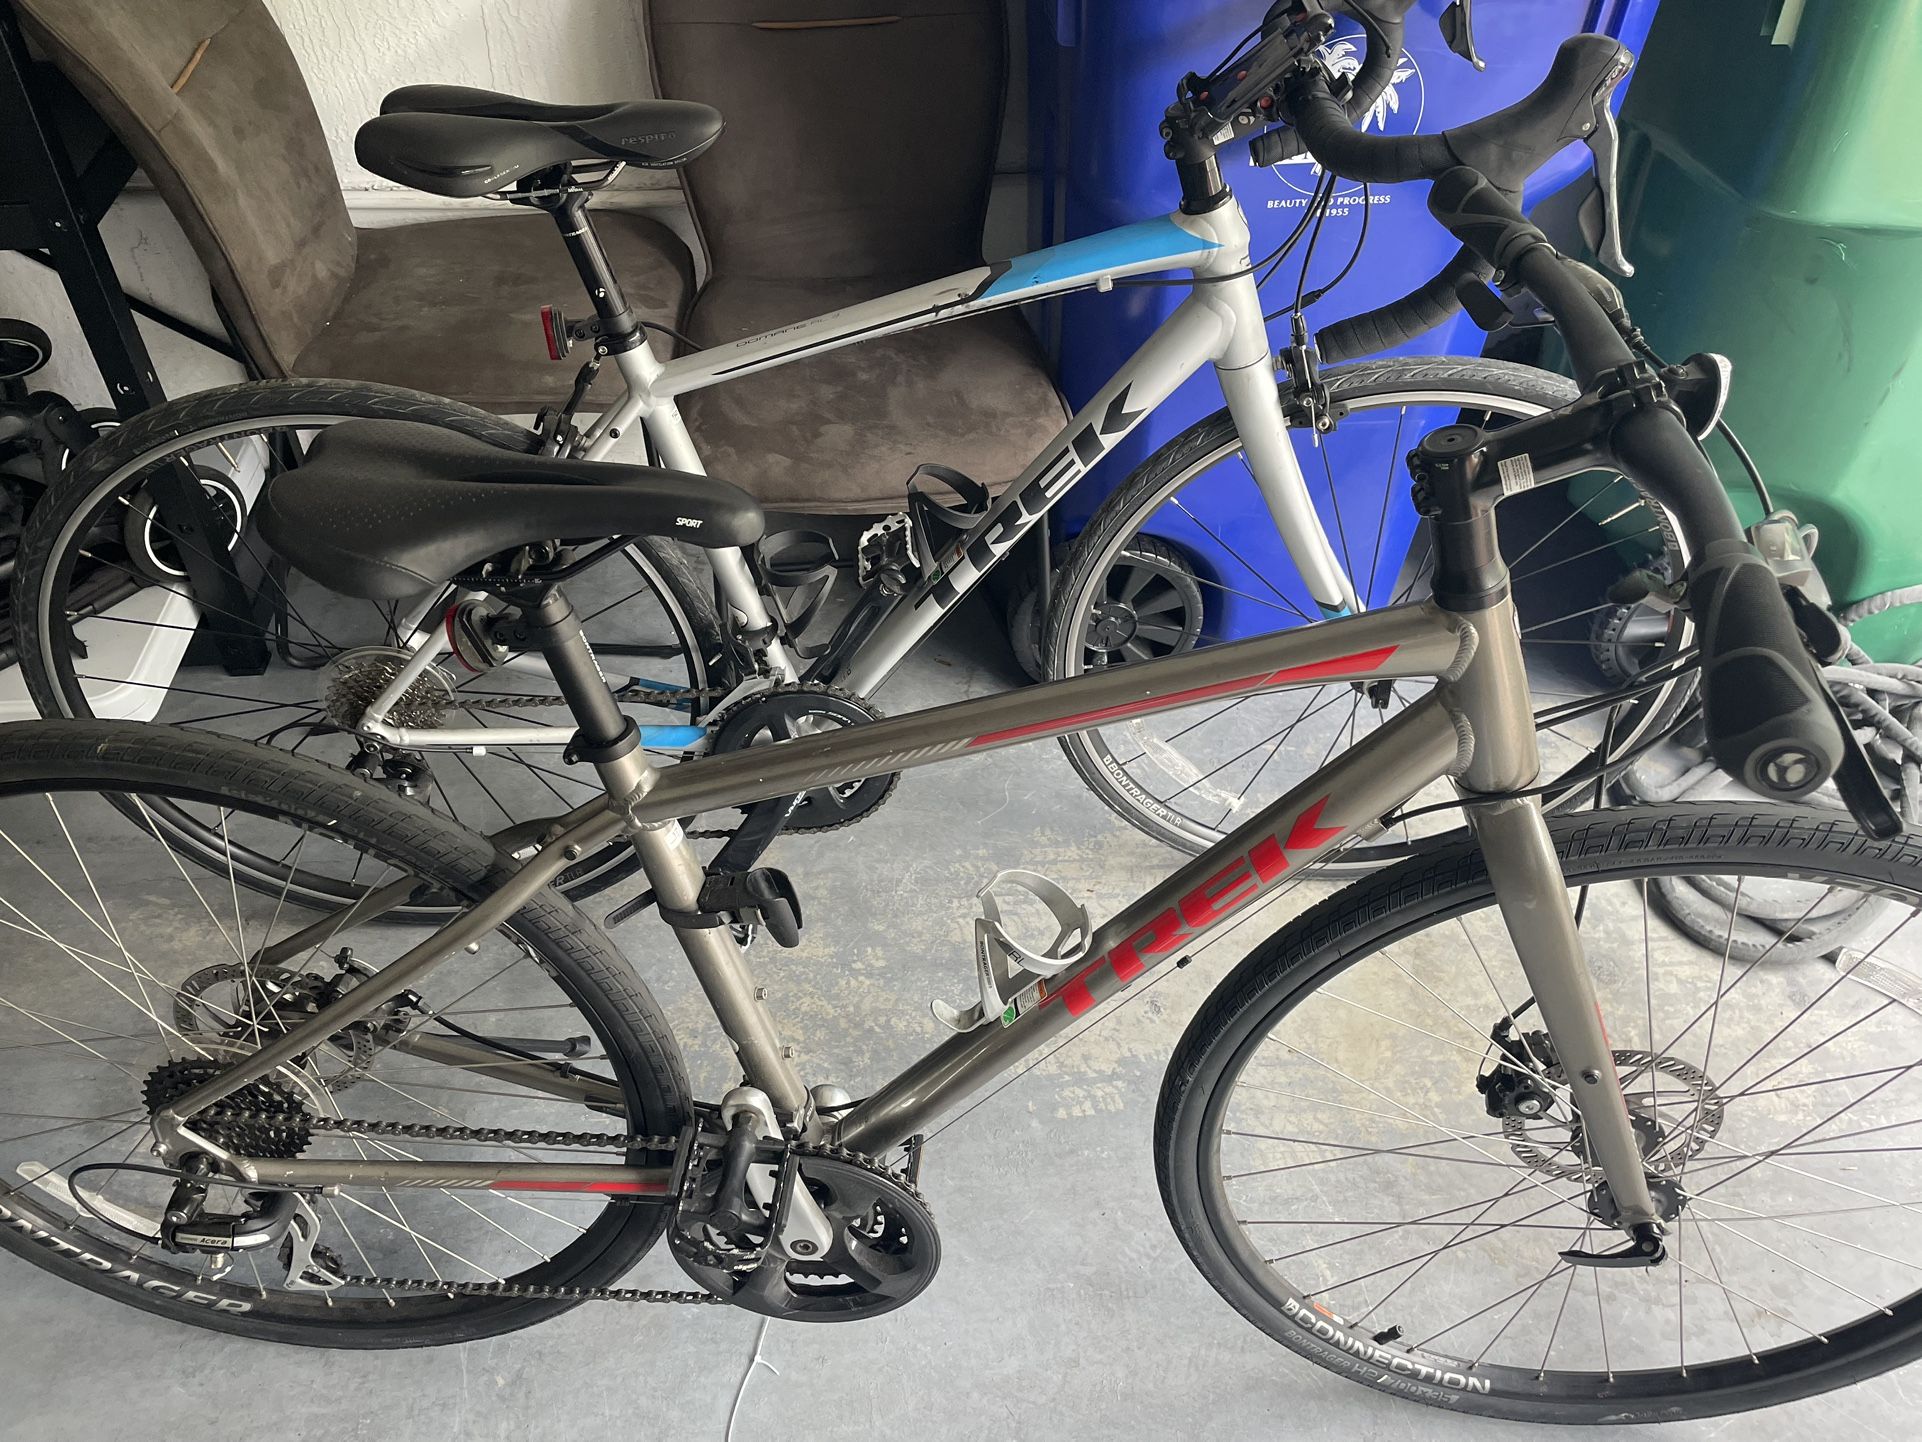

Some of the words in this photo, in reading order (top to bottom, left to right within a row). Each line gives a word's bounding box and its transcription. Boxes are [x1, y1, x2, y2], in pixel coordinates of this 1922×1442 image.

[1267, 198, 1308, 209] BEAUTY
[1325, 208, 1349, 217] 1955
[914, 379, 1148, 611] TREK
[675, 516, 704, 529] SPORT
[1107, 762, 1168, 818] BONTRAGER
[1166, 812, 1183, 827] TLR
[1038, 792, 1348, 1018] TREK
[1007, 950, 1025, 968] RL
[199, 1237, 228, 1246] Acera
[1284, 1328, 1351, 1369] BONTRAGER
[1294, 1308, 1491, 1395] CONNECTION
